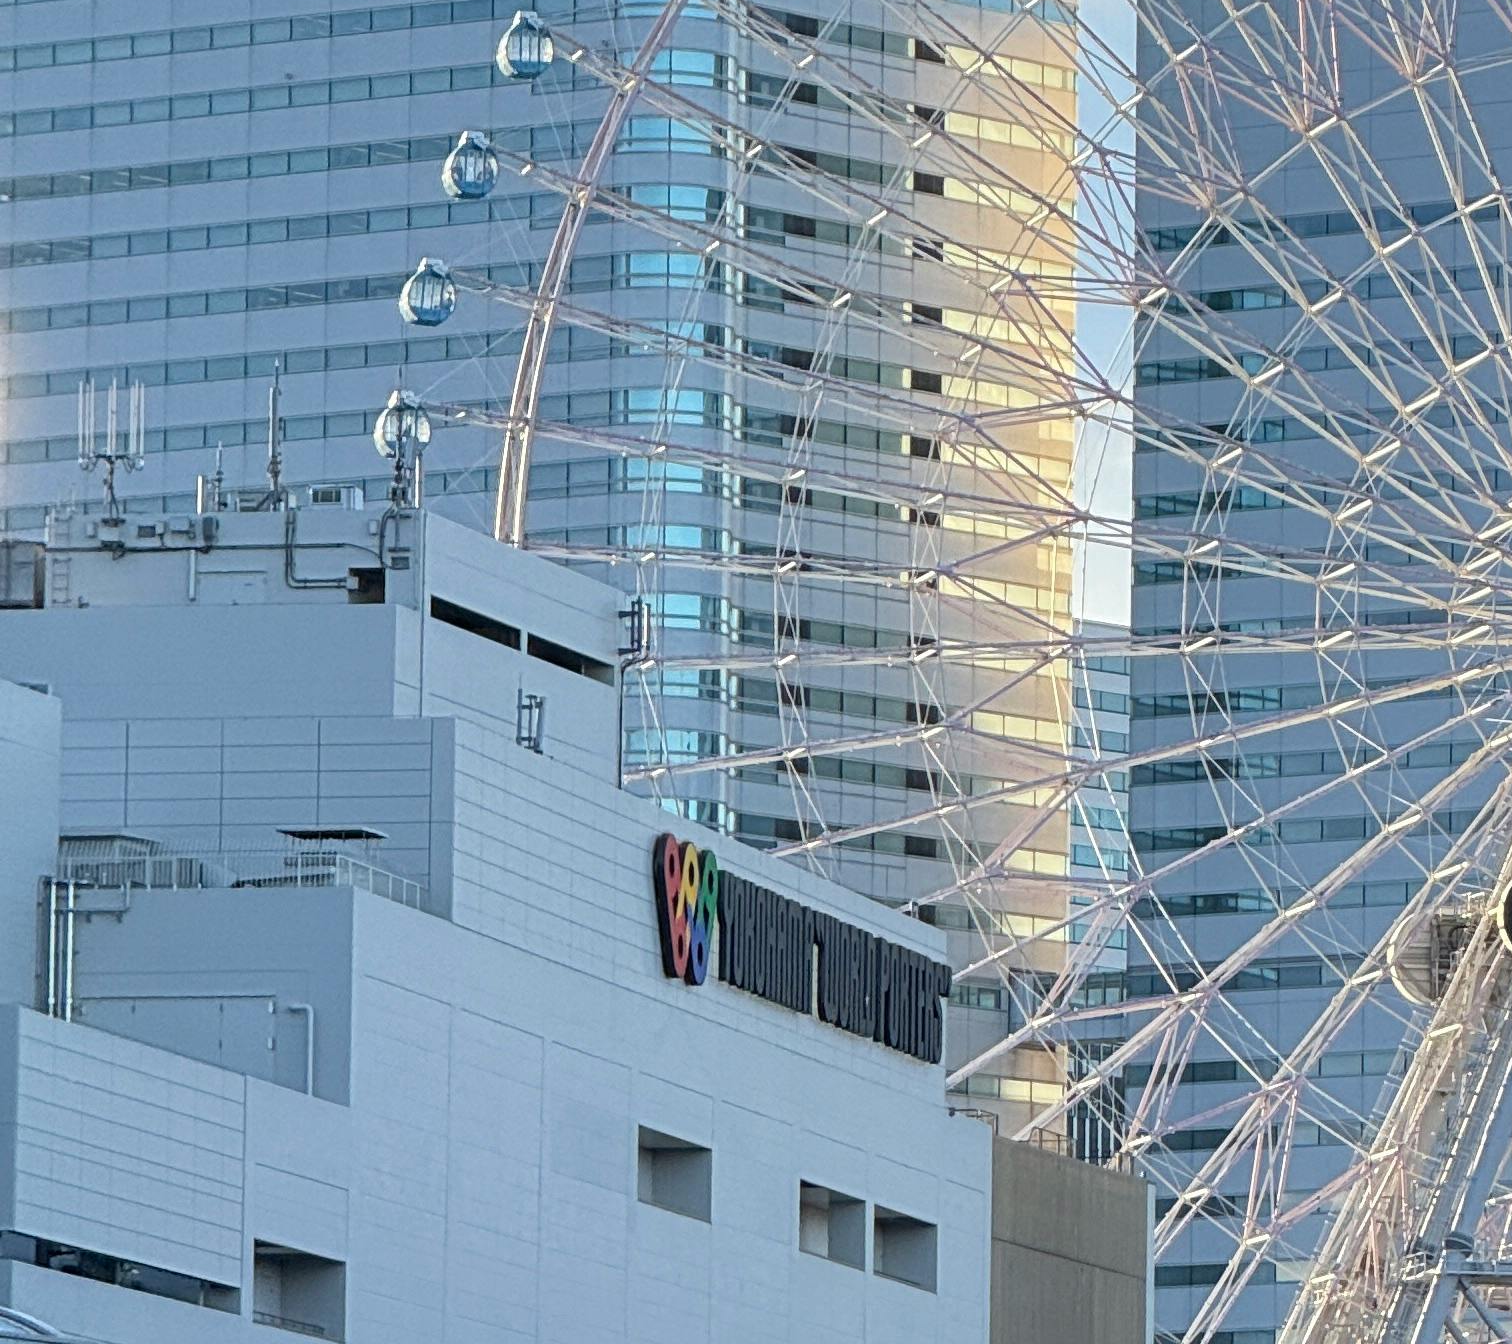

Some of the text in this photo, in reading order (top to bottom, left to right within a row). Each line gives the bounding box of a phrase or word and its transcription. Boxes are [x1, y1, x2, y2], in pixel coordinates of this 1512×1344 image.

[718, 869, 952, 1064] YOKOHAMA WORLD PORTERS
